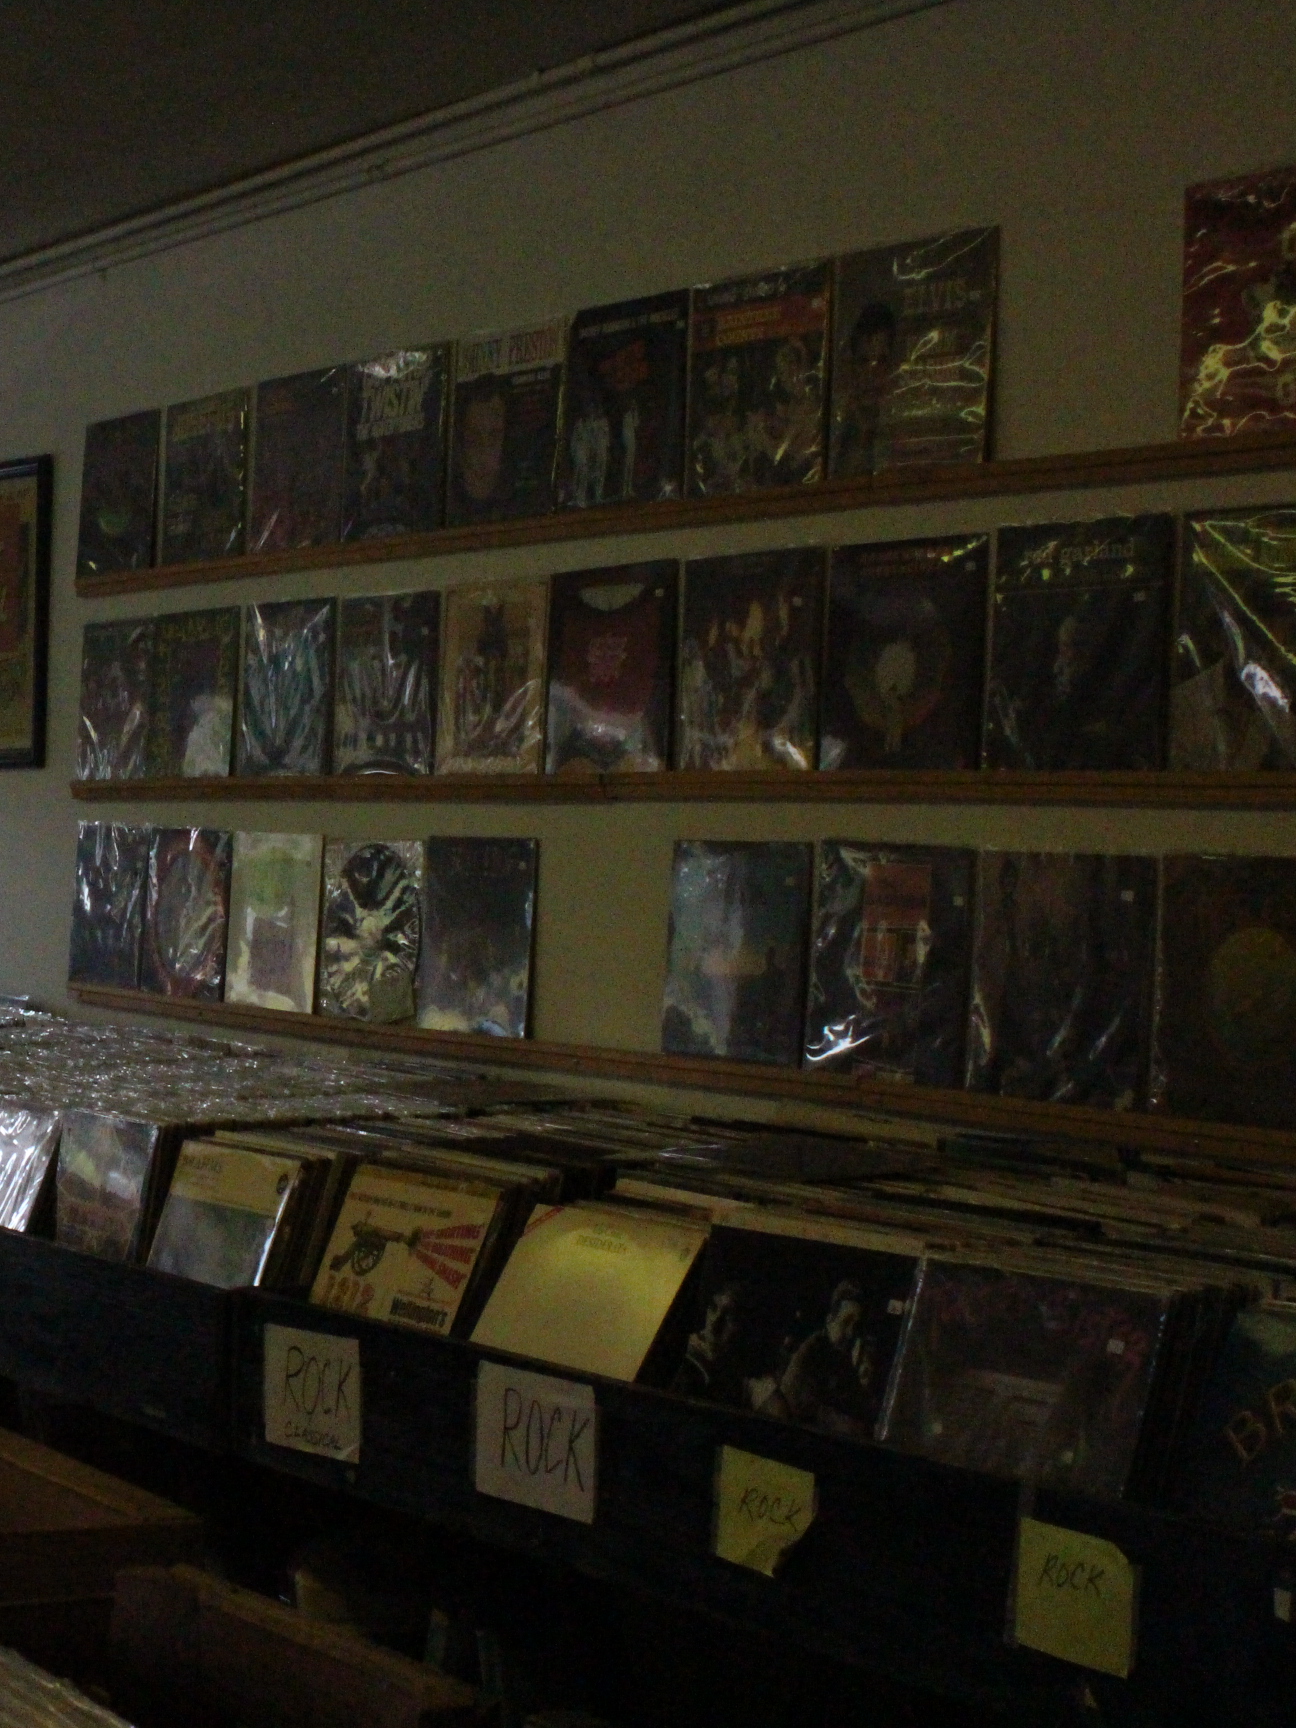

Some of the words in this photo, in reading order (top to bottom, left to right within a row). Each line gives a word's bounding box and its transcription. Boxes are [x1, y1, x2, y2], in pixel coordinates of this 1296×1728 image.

[902, 277, 967, 314] ELVIS
[1059, 537, 1135, 568] garland
[283, 1345, 353, 1419] ROCK
[500, 1387, 591, 1493] ROCK
[738, 1485, 801, 1528] ROCK
[1036, 1553, 1105, 1596] ROCK
